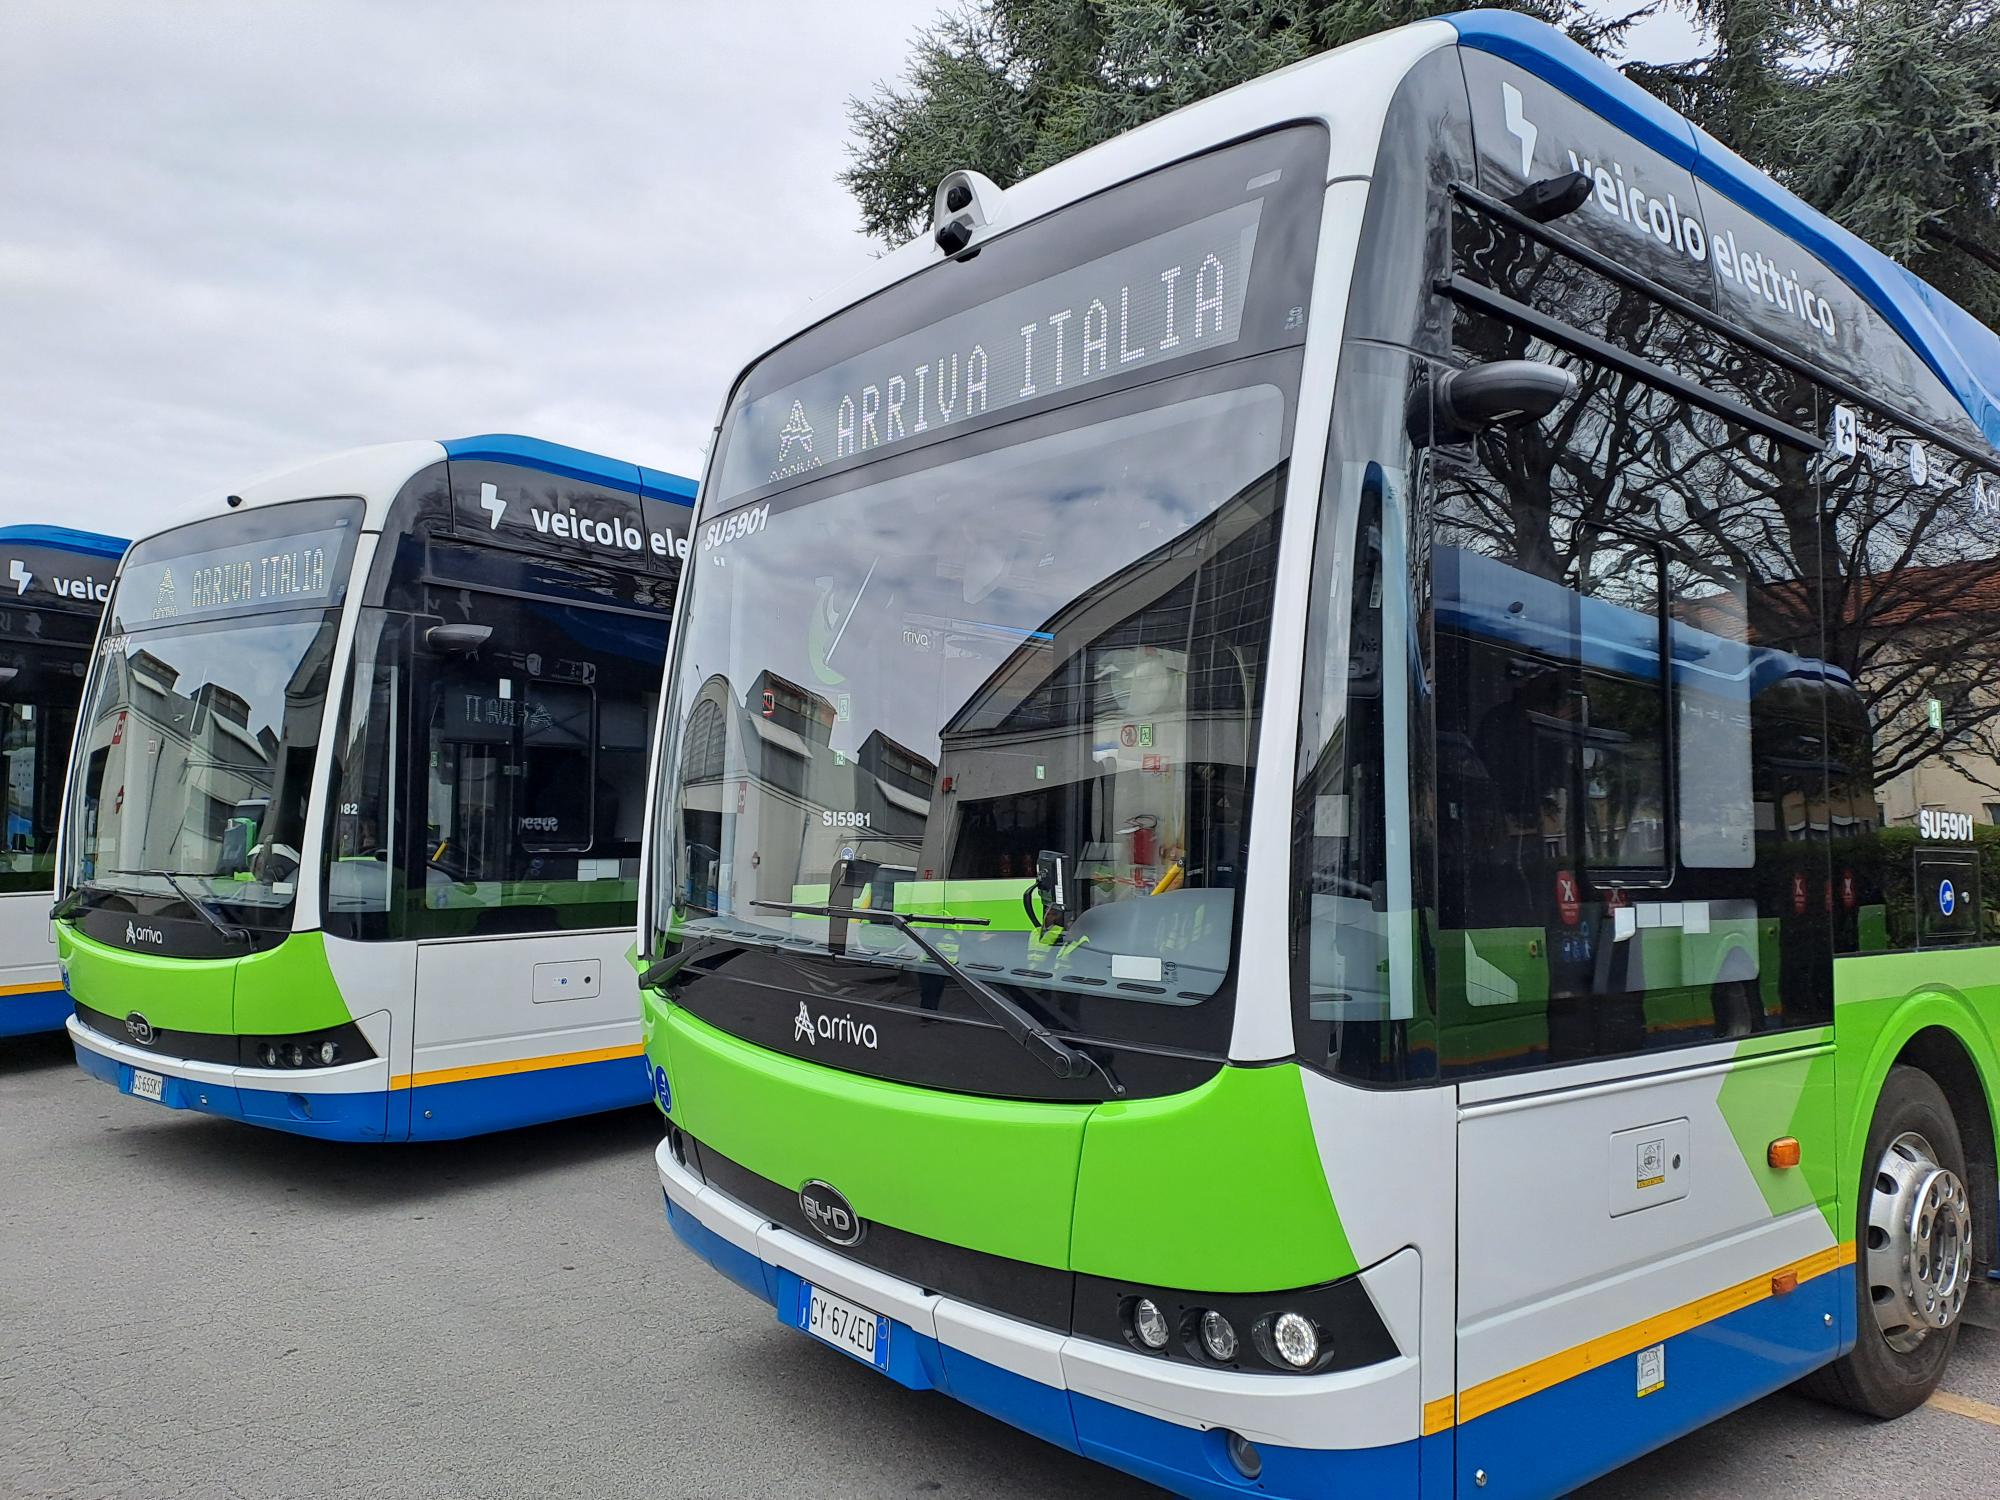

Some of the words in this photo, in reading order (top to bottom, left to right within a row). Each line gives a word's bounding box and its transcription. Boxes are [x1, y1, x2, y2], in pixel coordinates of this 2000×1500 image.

[1712, 229, 1835, 335] elettrico
[837, 344, 988, 457] ARRIVA
[1020, 252, 1224, 398] ITALIA
[1856, 421, 1888, 447] Regione
[531, 507, 642, 550] veicolo
[704, 503, 770, 551] SU5901
[192, 561, 252, 607] ARRIVA
[260, 548, 324, 598] ITALIA
[822, 811, 871, 827] SI5981
[1920, 809, 1974, 842] SU5901
[136, 926, 163, 944] arriva
[817, 1013, 877, 1049] arriva
[803, 1195, 850, 1231] BYD
